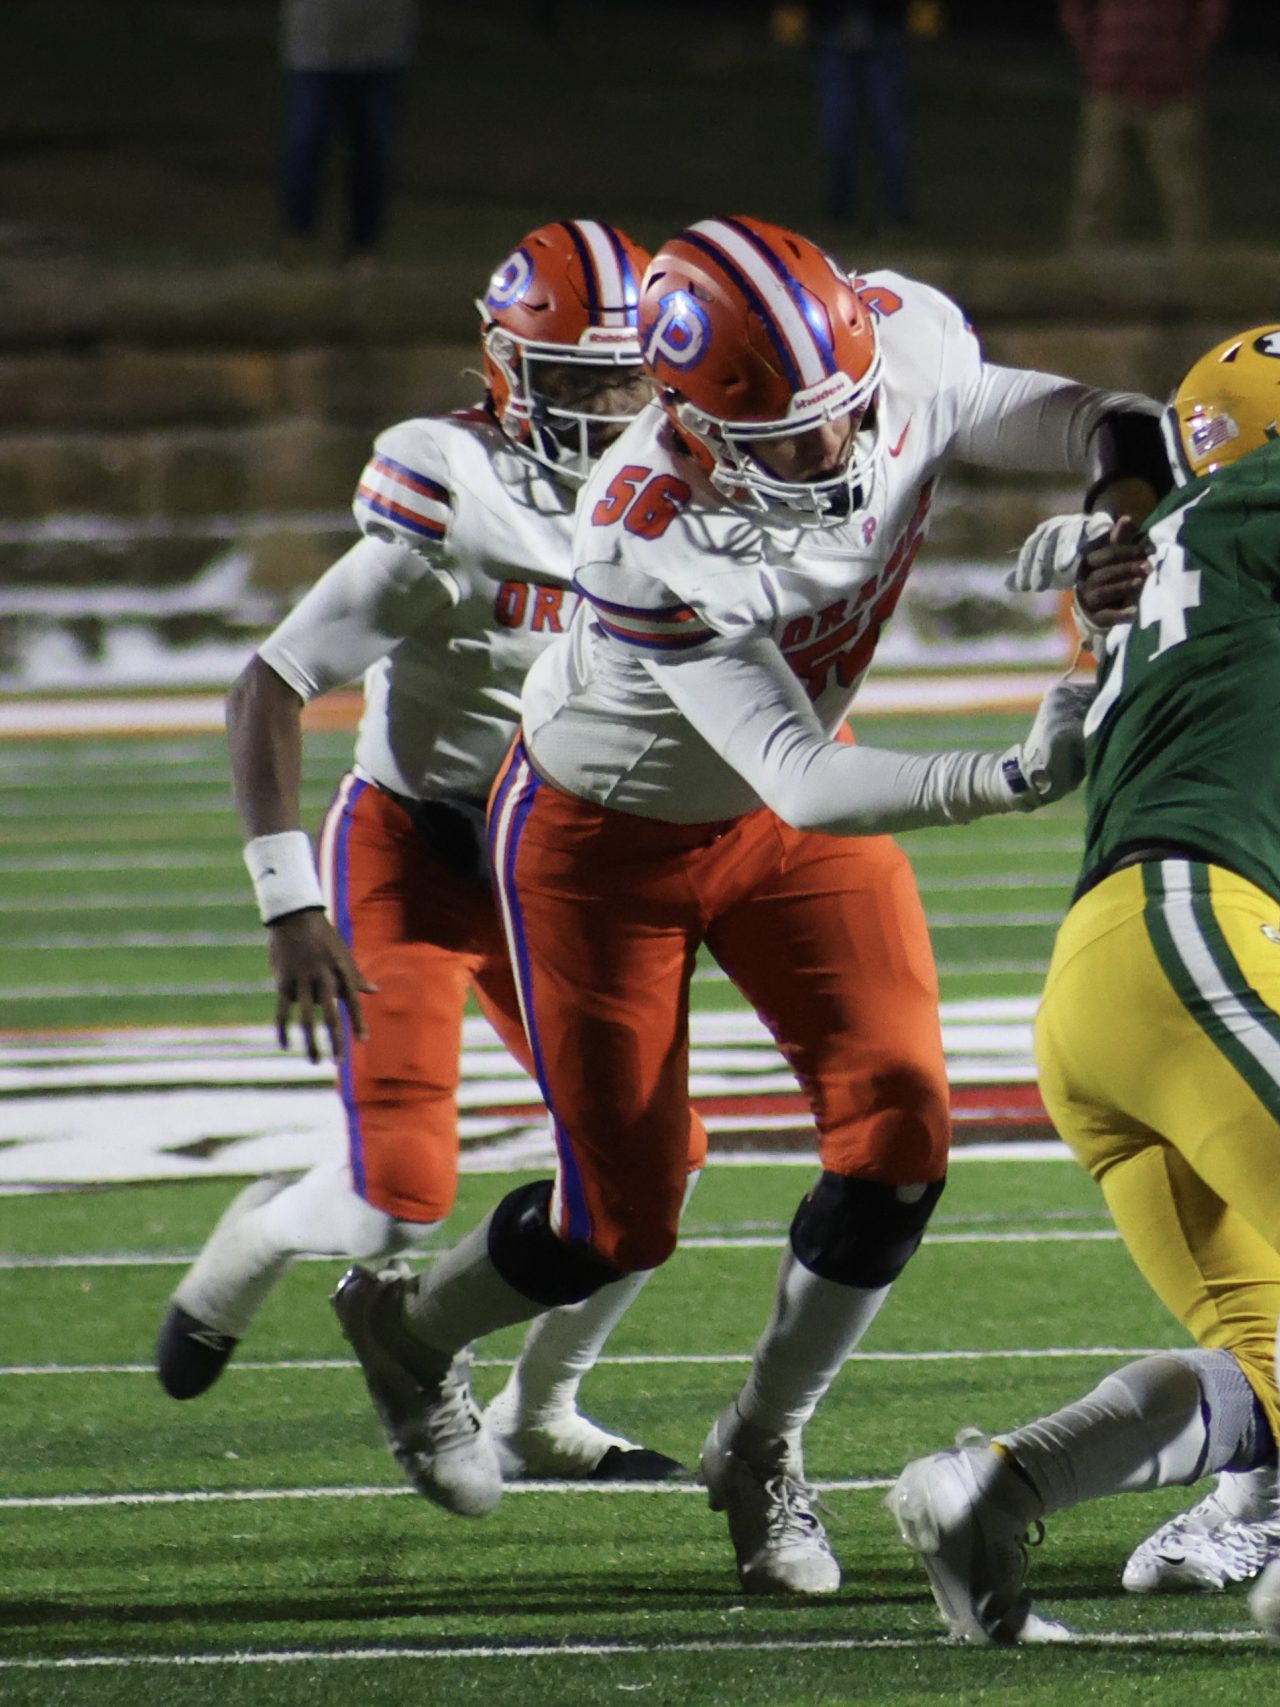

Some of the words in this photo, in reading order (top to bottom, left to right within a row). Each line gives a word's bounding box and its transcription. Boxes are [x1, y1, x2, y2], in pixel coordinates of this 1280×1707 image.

[645, 289, 711, 371] P
[591, 464, 692, 542] 56
[494, 580, 583, 634] OR
